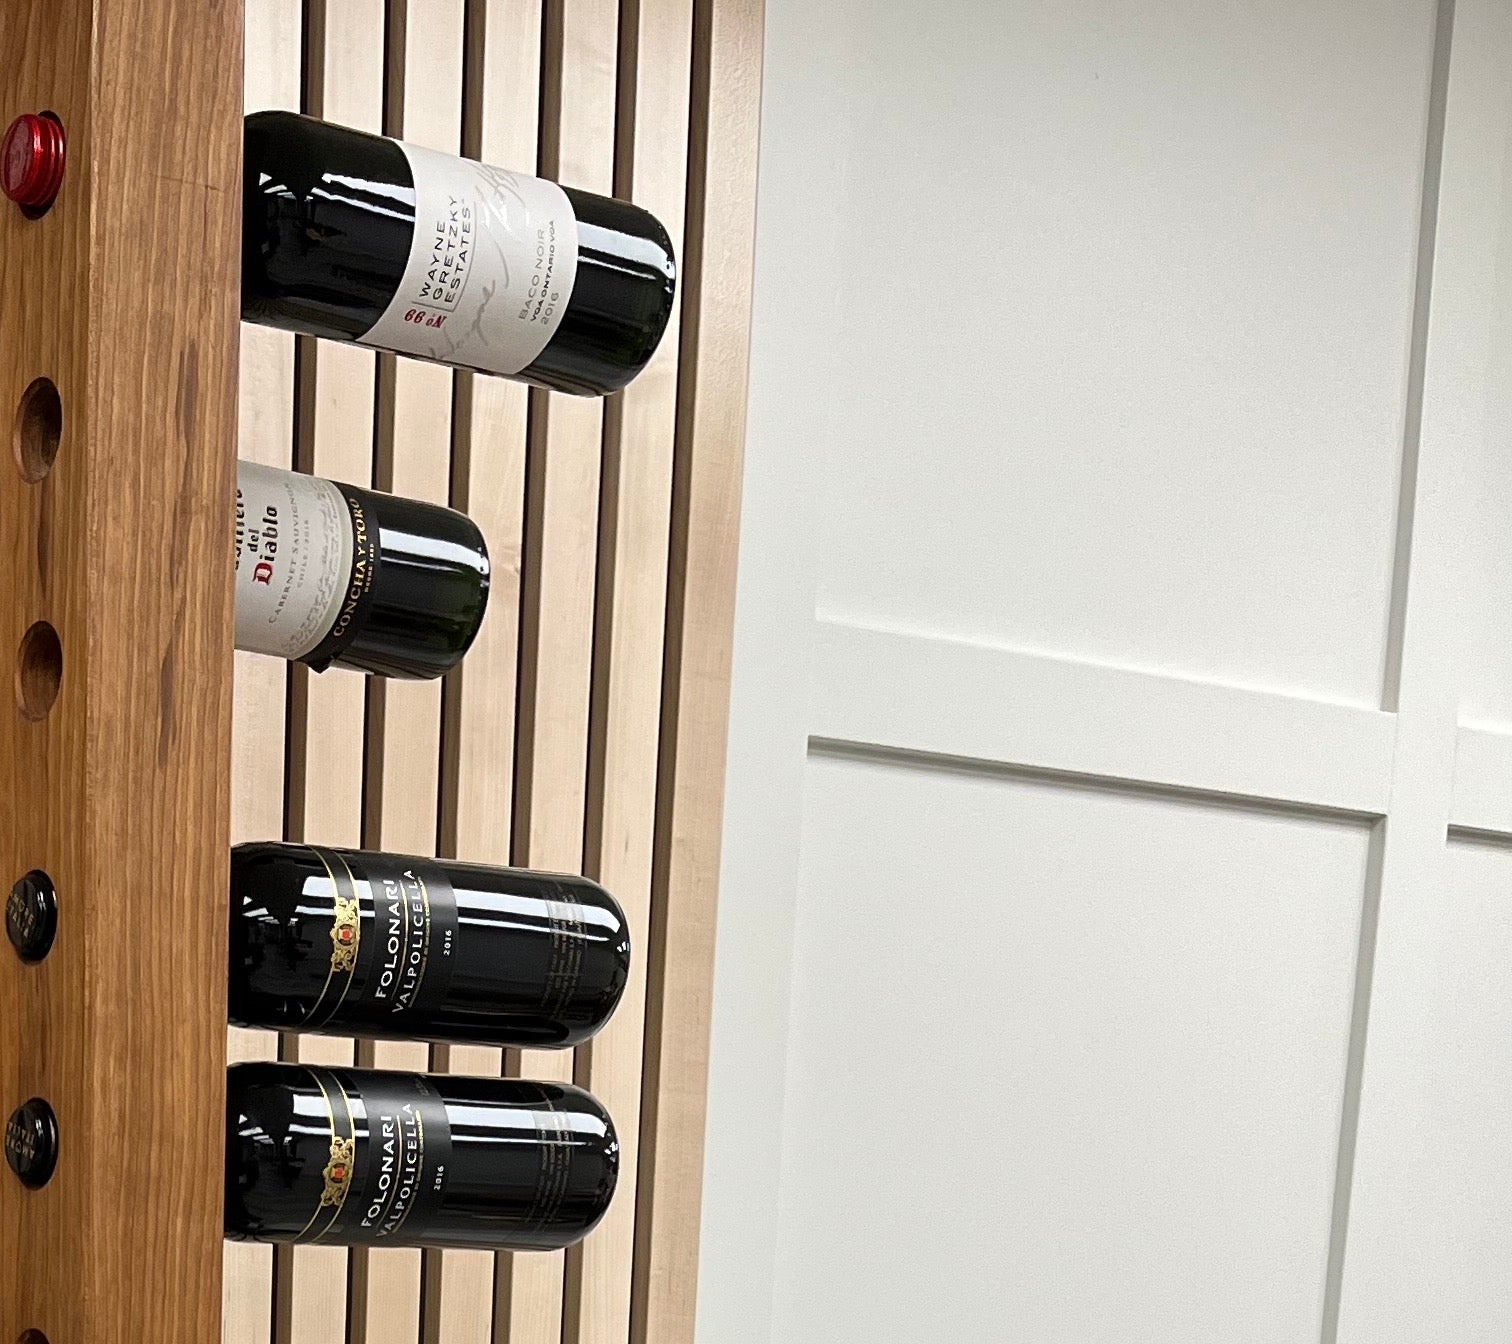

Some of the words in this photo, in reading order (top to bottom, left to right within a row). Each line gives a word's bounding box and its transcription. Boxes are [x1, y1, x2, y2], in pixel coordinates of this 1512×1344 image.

[419, 220, 445, 298] WAYNE
[432, 196, 458, 300] GRETZKY
[444, 206, 471, 303] ESTATES
[518, 274, 540, 320] BACO
[535, 229, 545, 269] NOIR
[404, 308, 426, 324] 99
[541, 292, 560, 325] 2016
[247, 528, 260, 553] del
[252, 505, 279, 586] Diablo
[349, 498, 368, 544] TORO
[333, 559, 367, 637] CONCHA
[375, 880, 401, 998] FOLONARI
[392, 870, 424, 1013] VALPOLICELLA
[443, 929, 452, 956] 2016
[360, 1115, 395, 1227] FOLONARI
[376, 1103, 417, 1237] VALPOLICELLA
[434, 1165, 444, 1191] 2016
